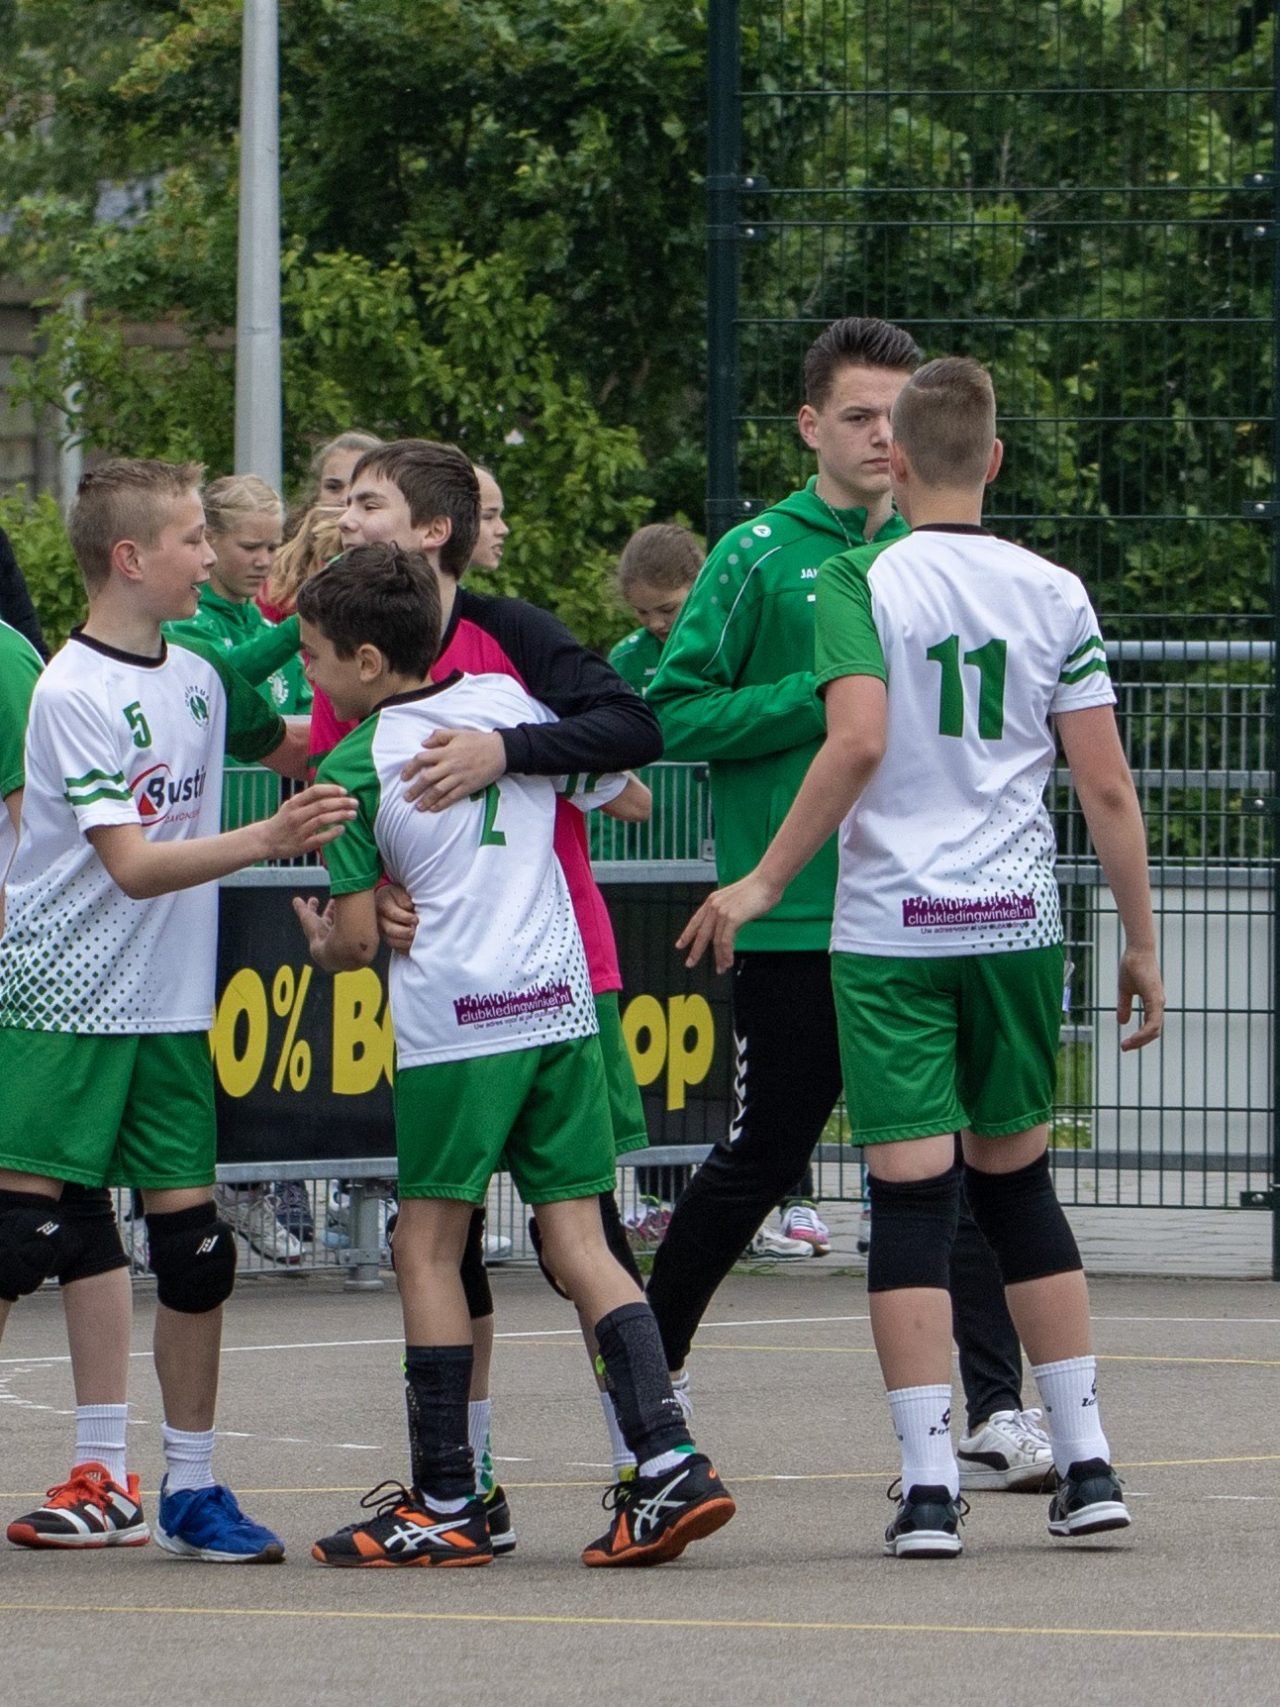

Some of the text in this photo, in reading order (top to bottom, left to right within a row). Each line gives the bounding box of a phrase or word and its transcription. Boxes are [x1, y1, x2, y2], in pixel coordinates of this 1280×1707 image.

[926, 634, 1007, 740] 11
[122, 700, 153, 748] 5
[908, 905, 1034, 926] clubkledingwinkel.nl
[208, 964, 313, 1098] 0%
[460, 991, 571, 1023] clubkledingwinkel.nl
